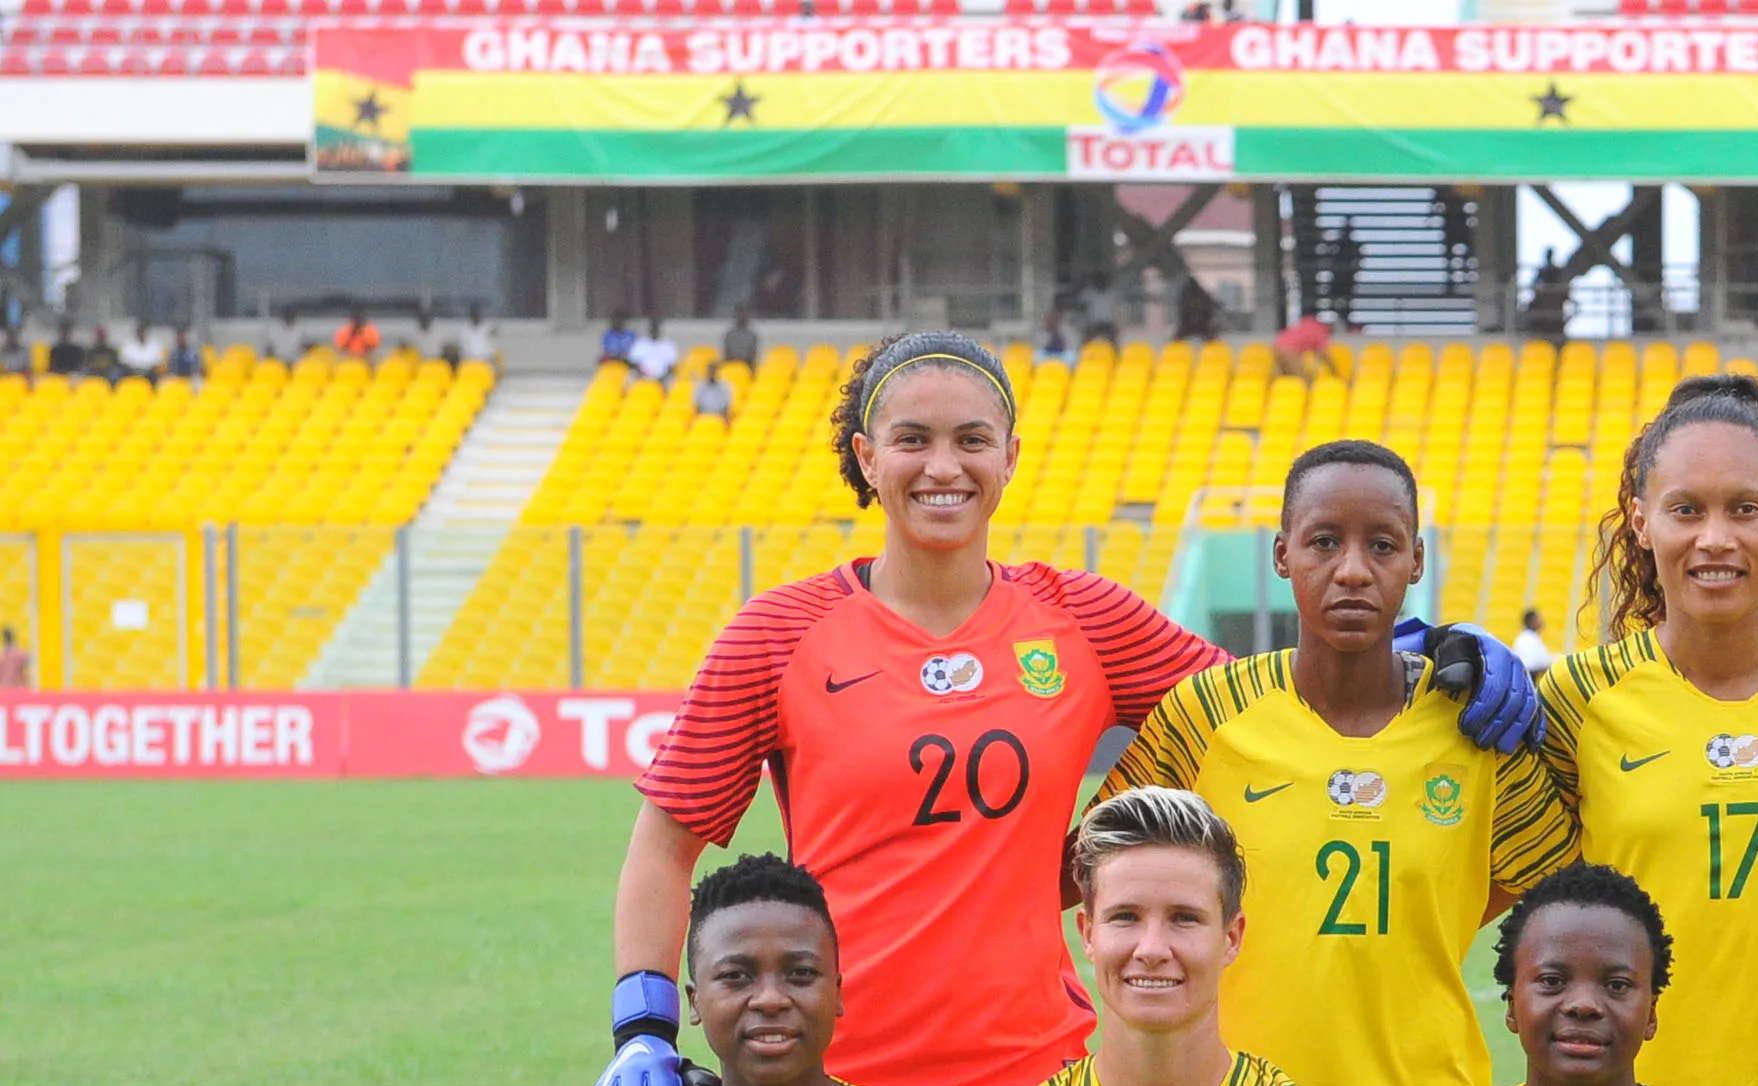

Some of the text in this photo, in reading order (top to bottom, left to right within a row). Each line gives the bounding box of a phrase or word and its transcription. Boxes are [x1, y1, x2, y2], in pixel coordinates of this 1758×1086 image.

[463, 26, 1071, 72] GHANA SUPPORTERS
[1231, 27, 1439, 71] GHANA
[1069, 134, 1234, 171] TOTAL
[909, 729, 1029, 826] 20
[1316, 840, 1391, 936] 21
